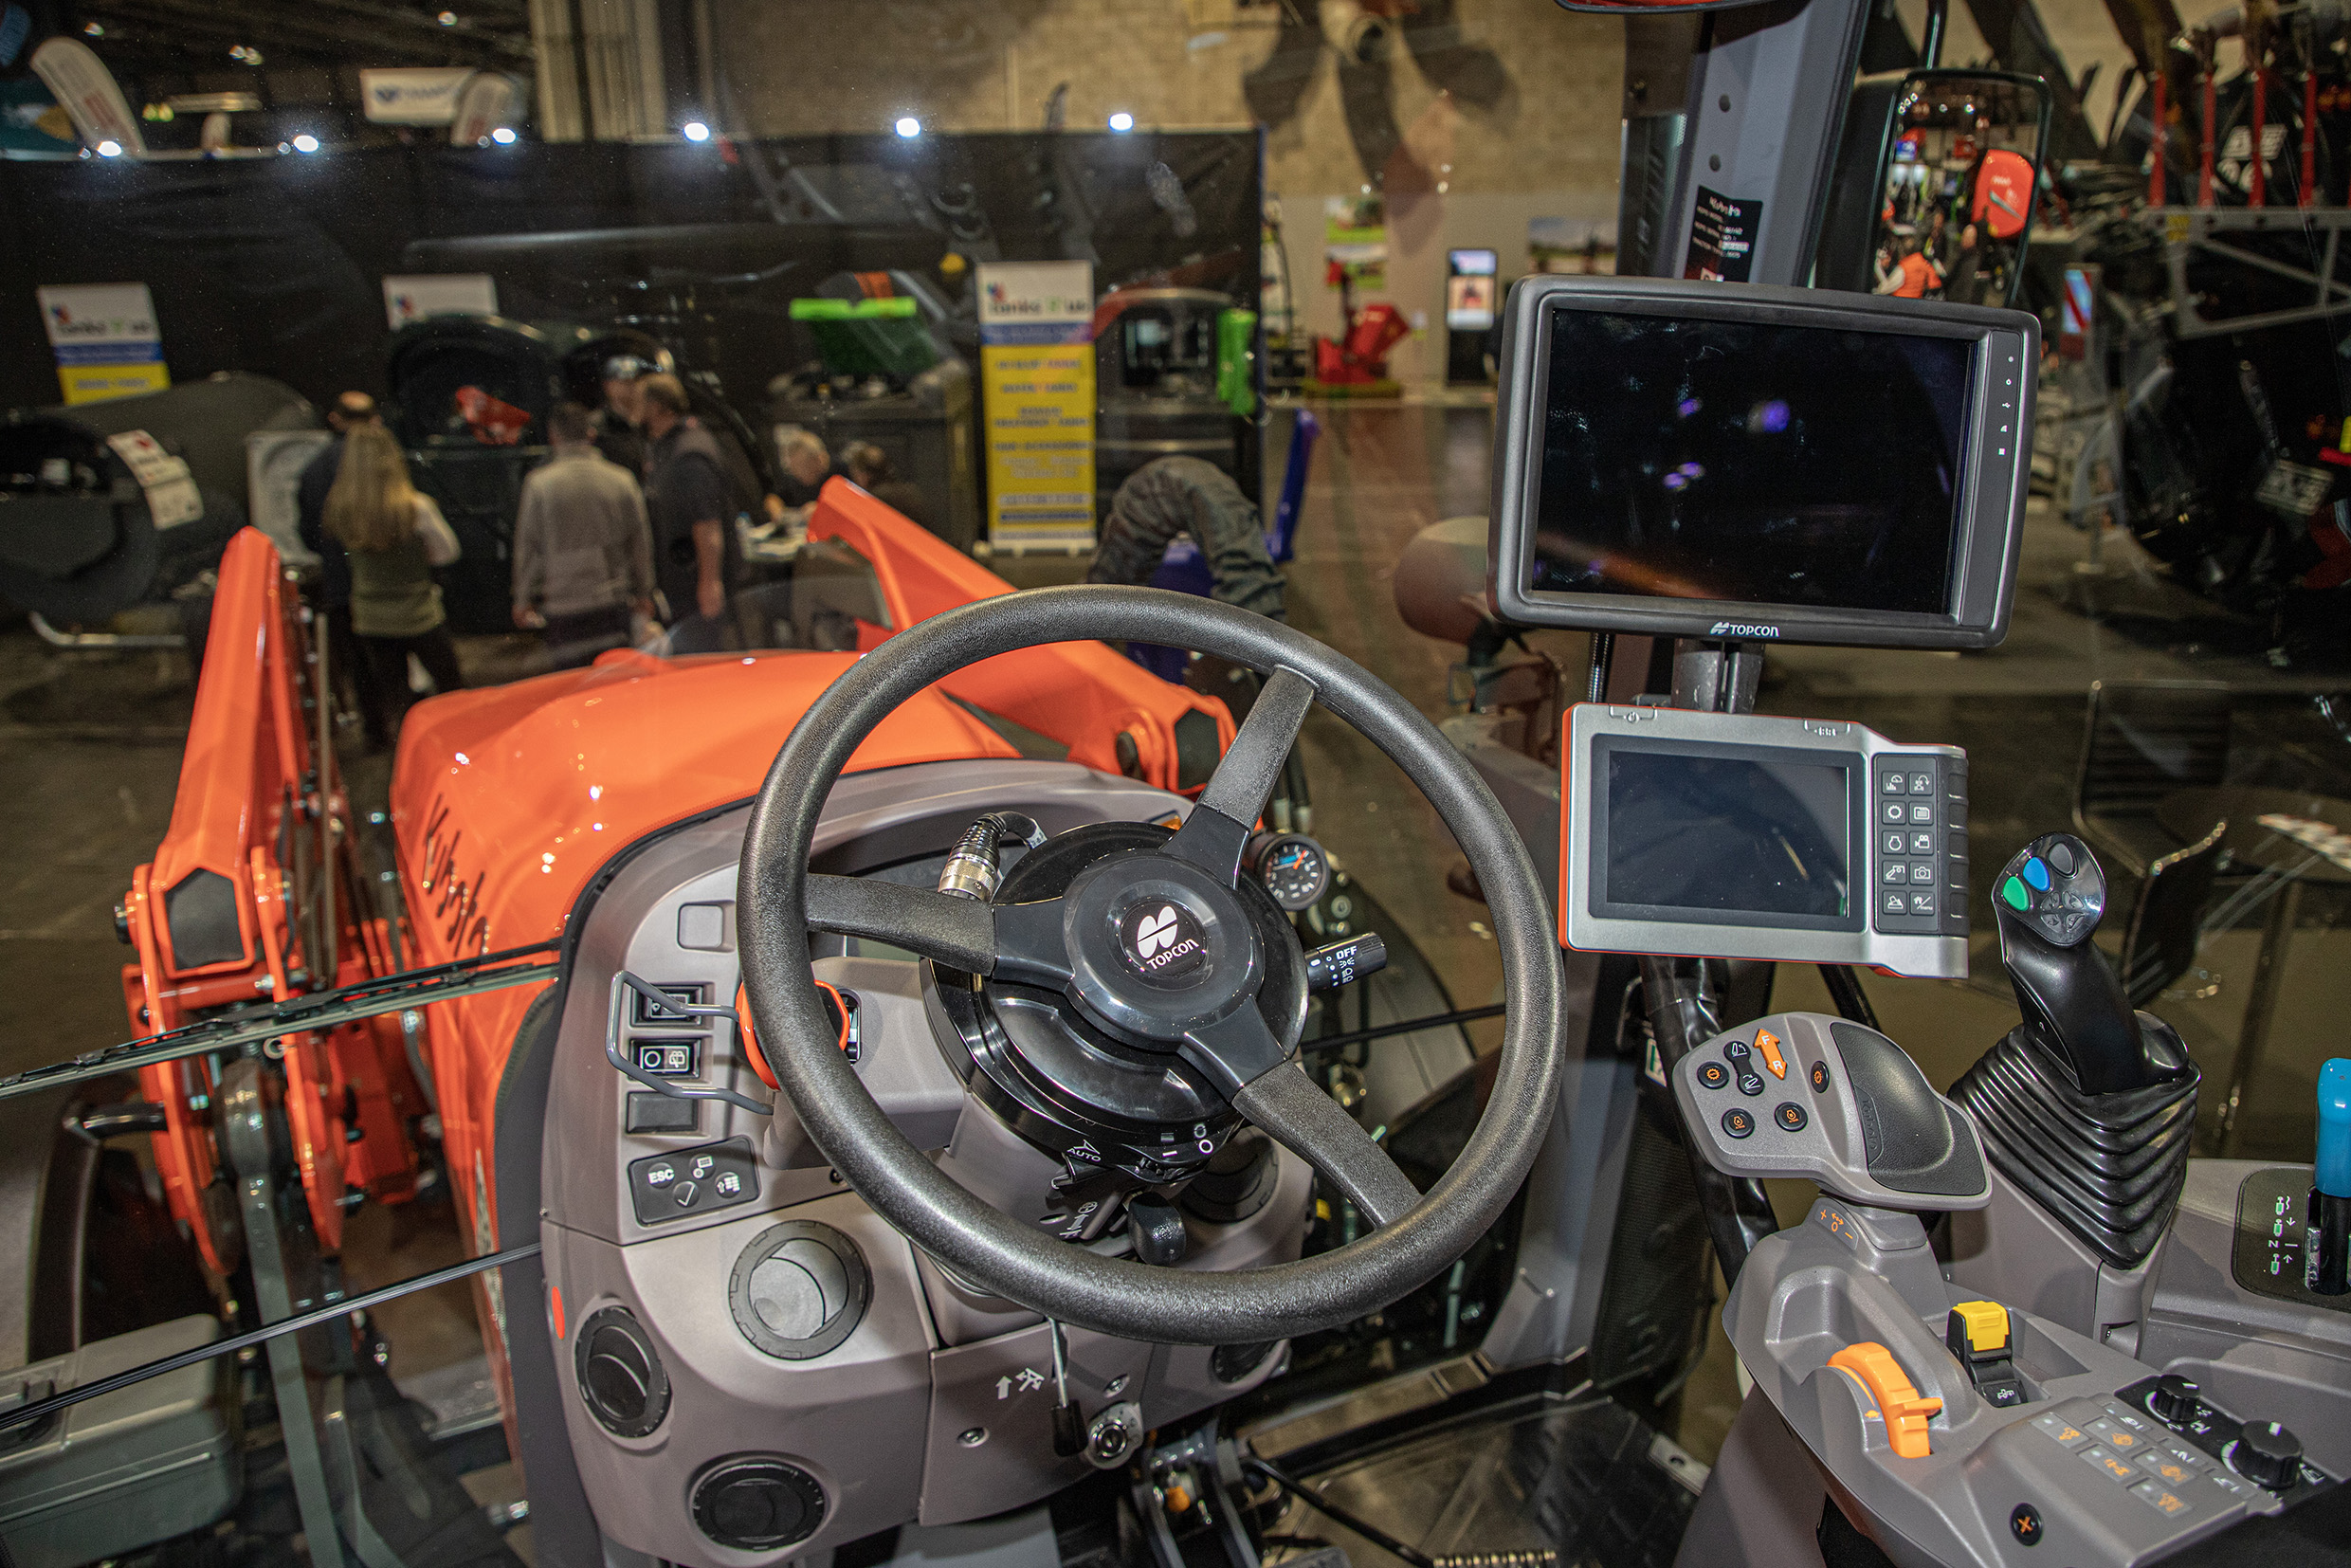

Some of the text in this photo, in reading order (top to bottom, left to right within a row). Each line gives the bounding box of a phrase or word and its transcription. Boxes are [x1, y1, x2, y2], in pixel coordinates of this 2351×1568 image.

[1730, 624, 1780, 638] TOPCON
[1146, 938, 1200, 970] TOPCON
[1336, 946, 1358, 960] OFF
[1761, 1034, 1771, 1046] F
[1772, 1059, 1784, 1070] R
[1066, 1147, 1102, 1162] AUTO
[648, 1168, 675, 1184] ESC
[2268, 1239, 2280, 1249] N
